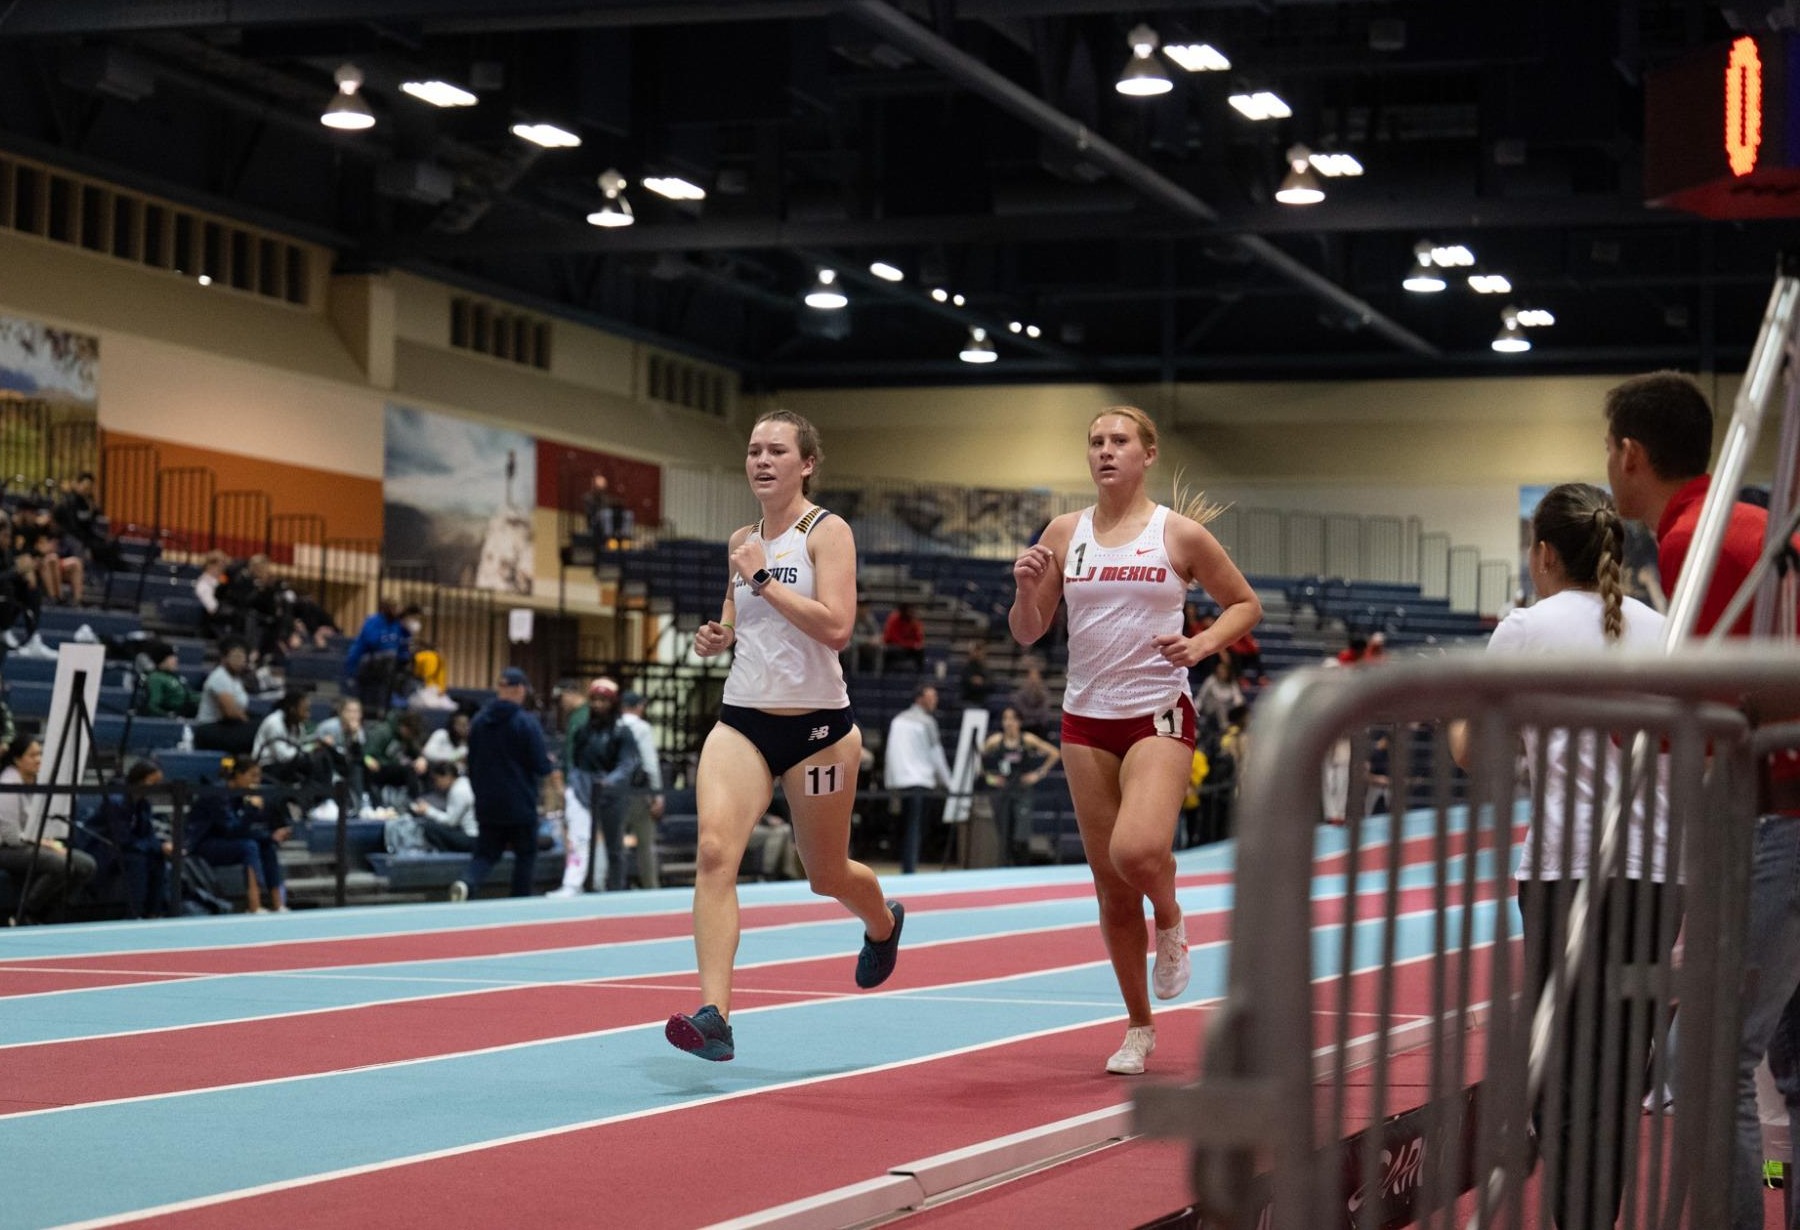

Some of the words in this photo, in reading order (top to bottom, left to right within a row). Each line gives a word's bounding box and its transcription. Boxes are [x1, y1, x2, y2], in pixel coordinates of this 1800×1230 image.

[1725, 36, 1762, 177] 0
[1074, 542, 1087, 577] 1
[1098, 565, 1167, 583] MEXICO
[1161, 708, 1175, 734] 1
[807, 766, 836, 795] 11
